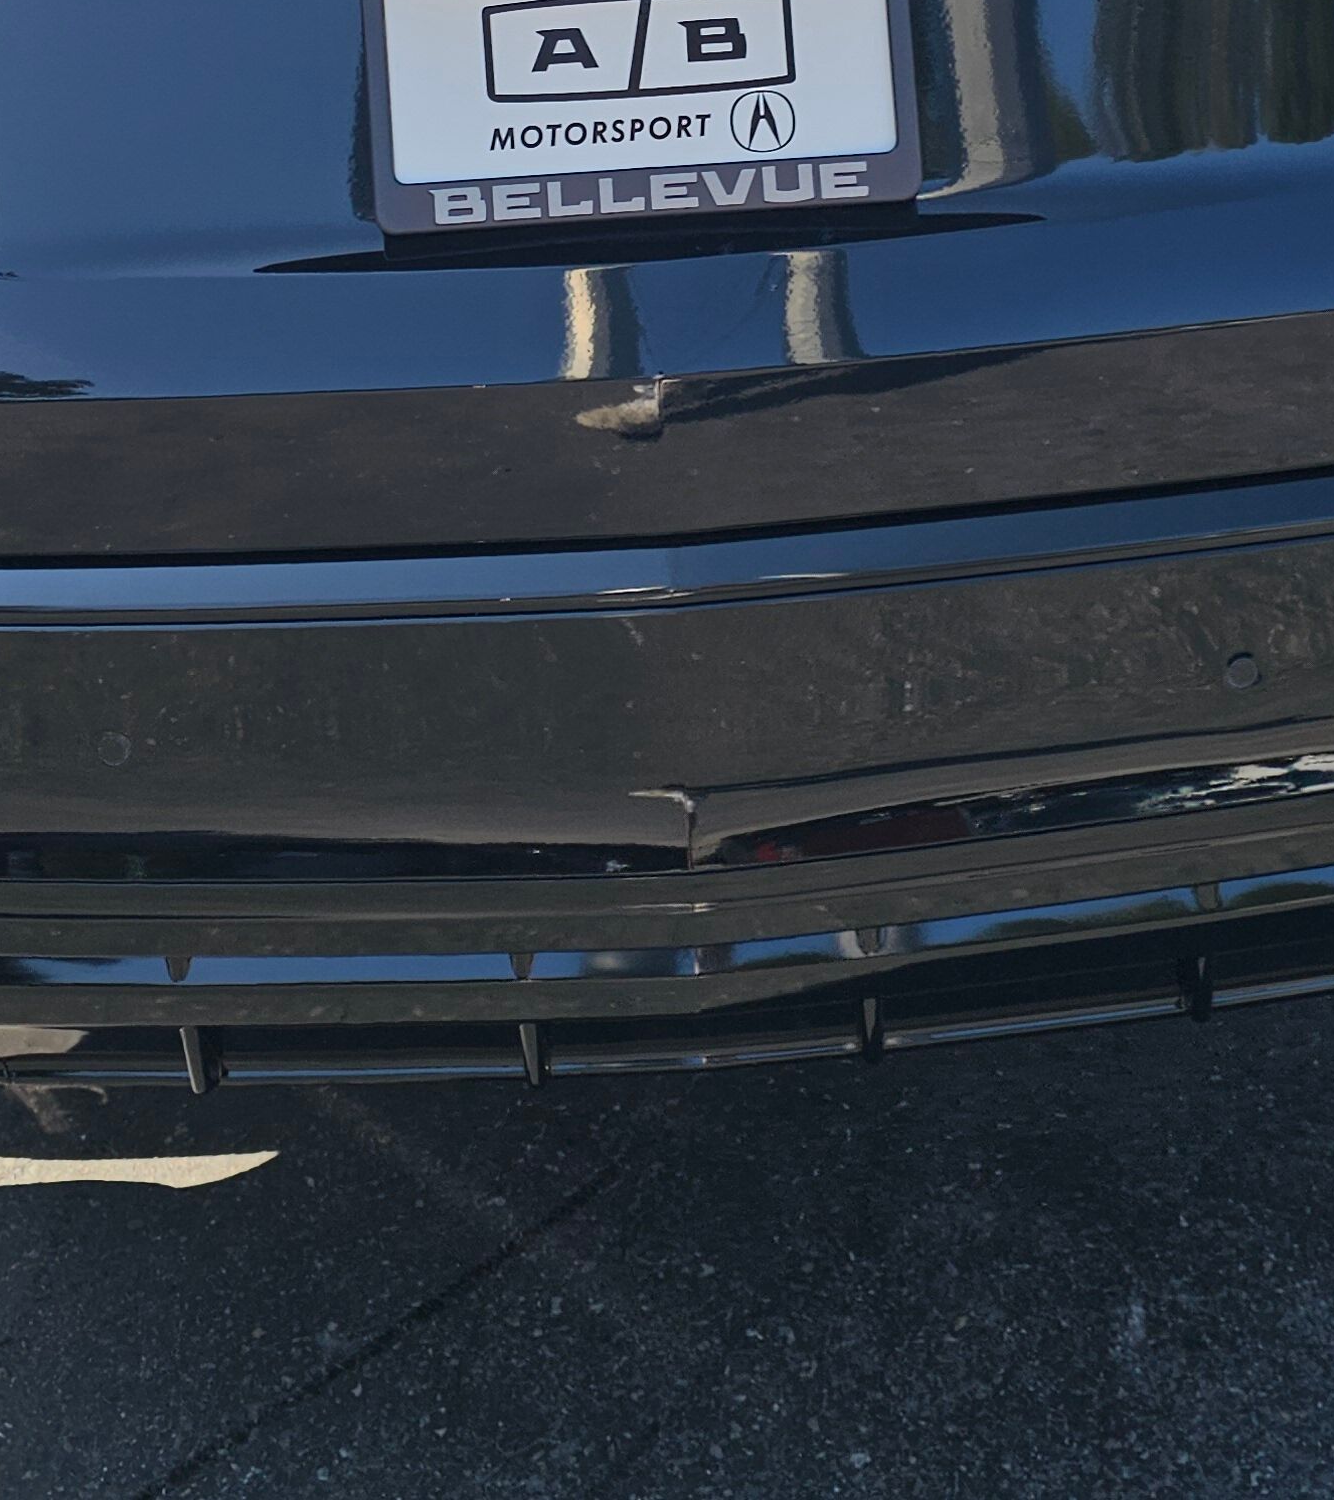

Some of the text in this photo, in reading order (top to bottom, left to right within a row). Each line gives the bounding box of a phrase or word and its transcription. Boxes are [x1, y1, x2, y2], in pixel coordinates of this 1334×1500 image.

[531, 17, 747, 73] A B
[489, 113, 713, 152] MOTORSPORT
[428, 161, 870, 225] BELLEVUE
